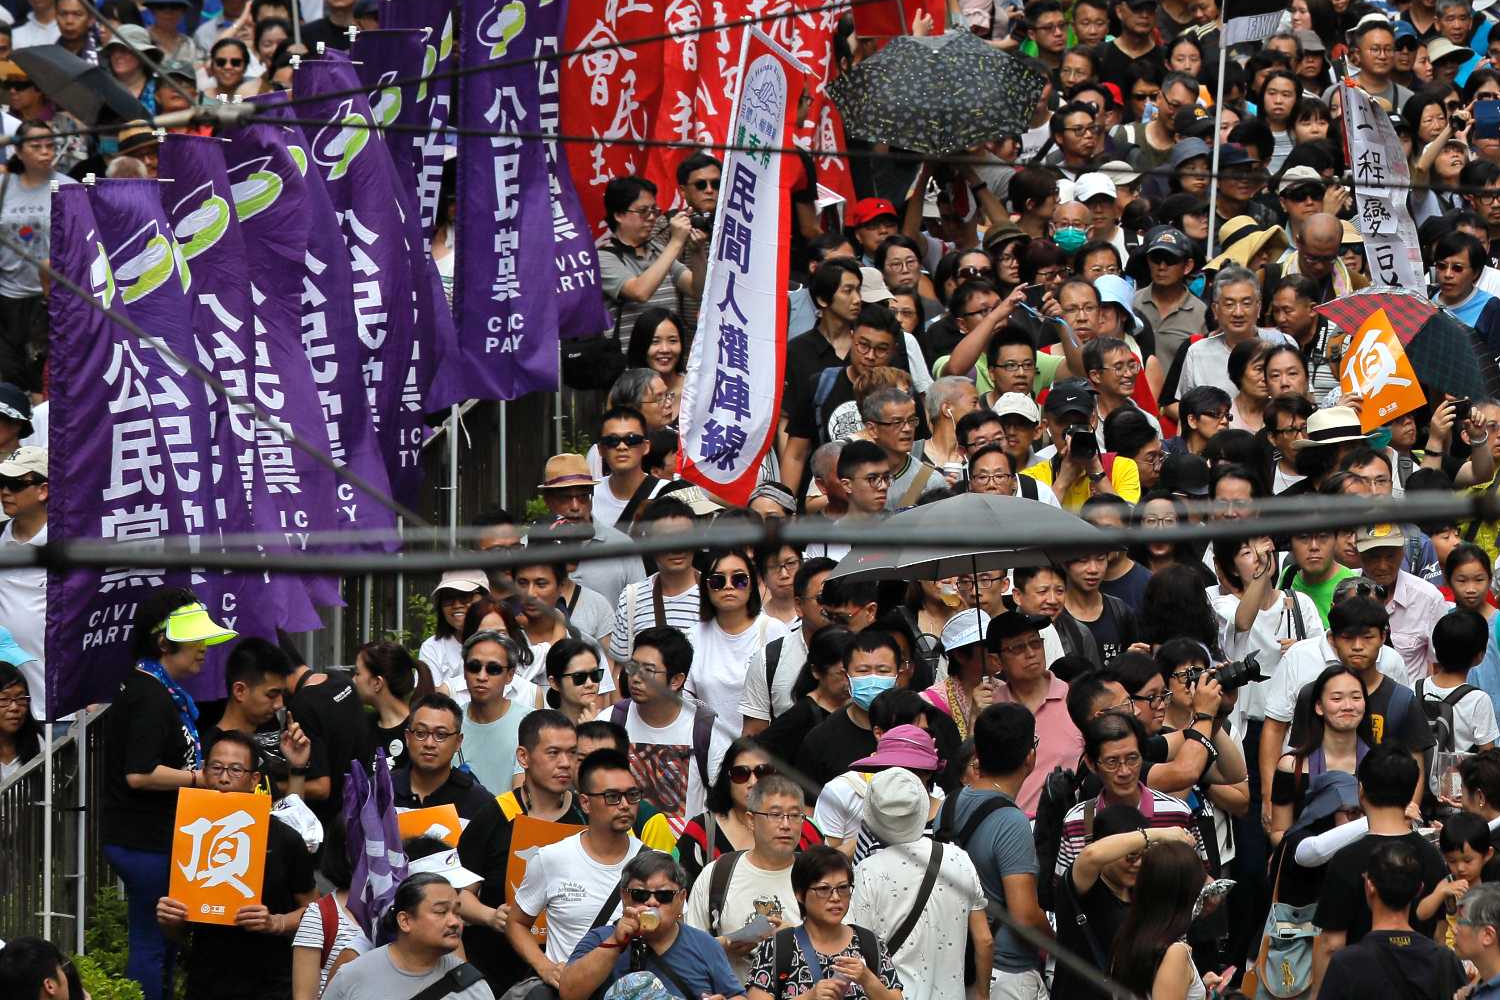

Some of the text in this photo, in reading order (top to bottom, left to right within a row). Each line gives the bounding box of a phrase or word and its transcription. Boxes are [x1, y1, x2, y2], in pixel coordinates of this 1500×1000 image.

[699, 160, 758, 473] 民間人權陣線
[1200, 736, 1218, 756] SONY
[176, 809, 257, 899] 頂
